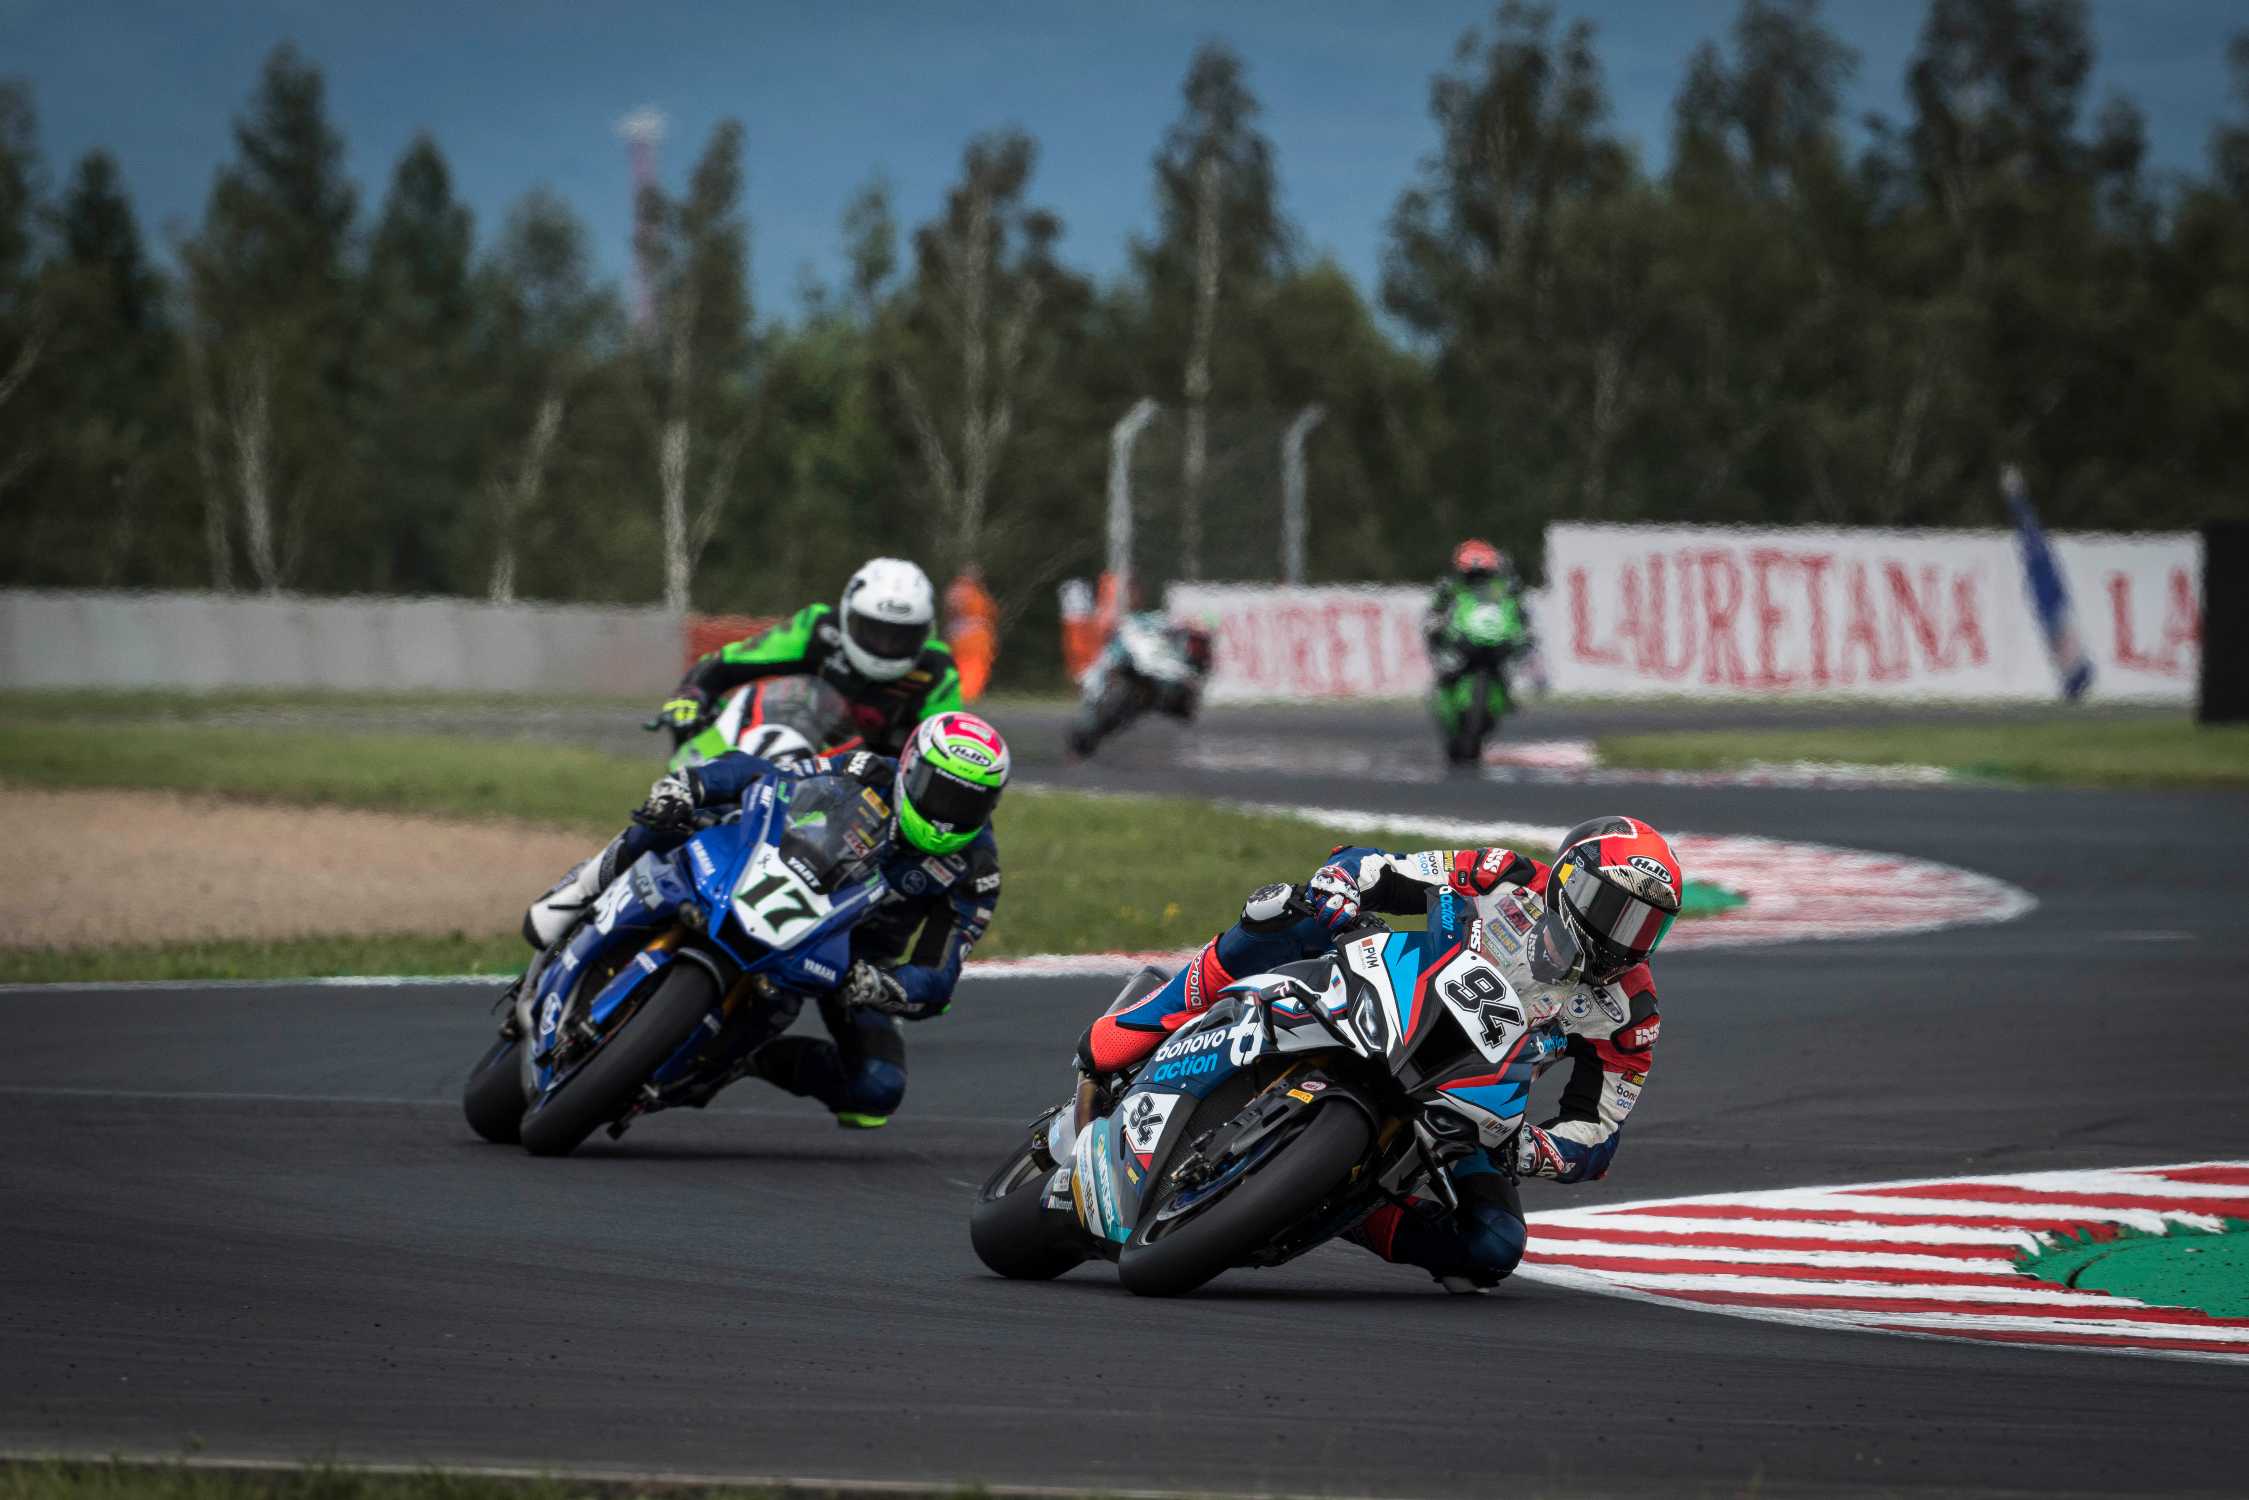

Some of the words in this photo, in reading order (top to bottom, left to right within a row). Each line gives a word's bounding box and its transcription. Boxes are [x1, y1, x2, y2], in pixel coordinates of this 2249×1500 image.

[1569, 547, 1989, 688] LAURETANA
[1633, 858, 1669, 881] HJC
[737, 872, 822, 935] 17
[803, 957, 836, 983] YAMAHA
[1363, 947, 1379, 969] PVM
[1443, 965, 1527, 1050] 94
[1155, 1028, 1227, 1063] bonovo
[1153, 1052, 1219, 1083] action
